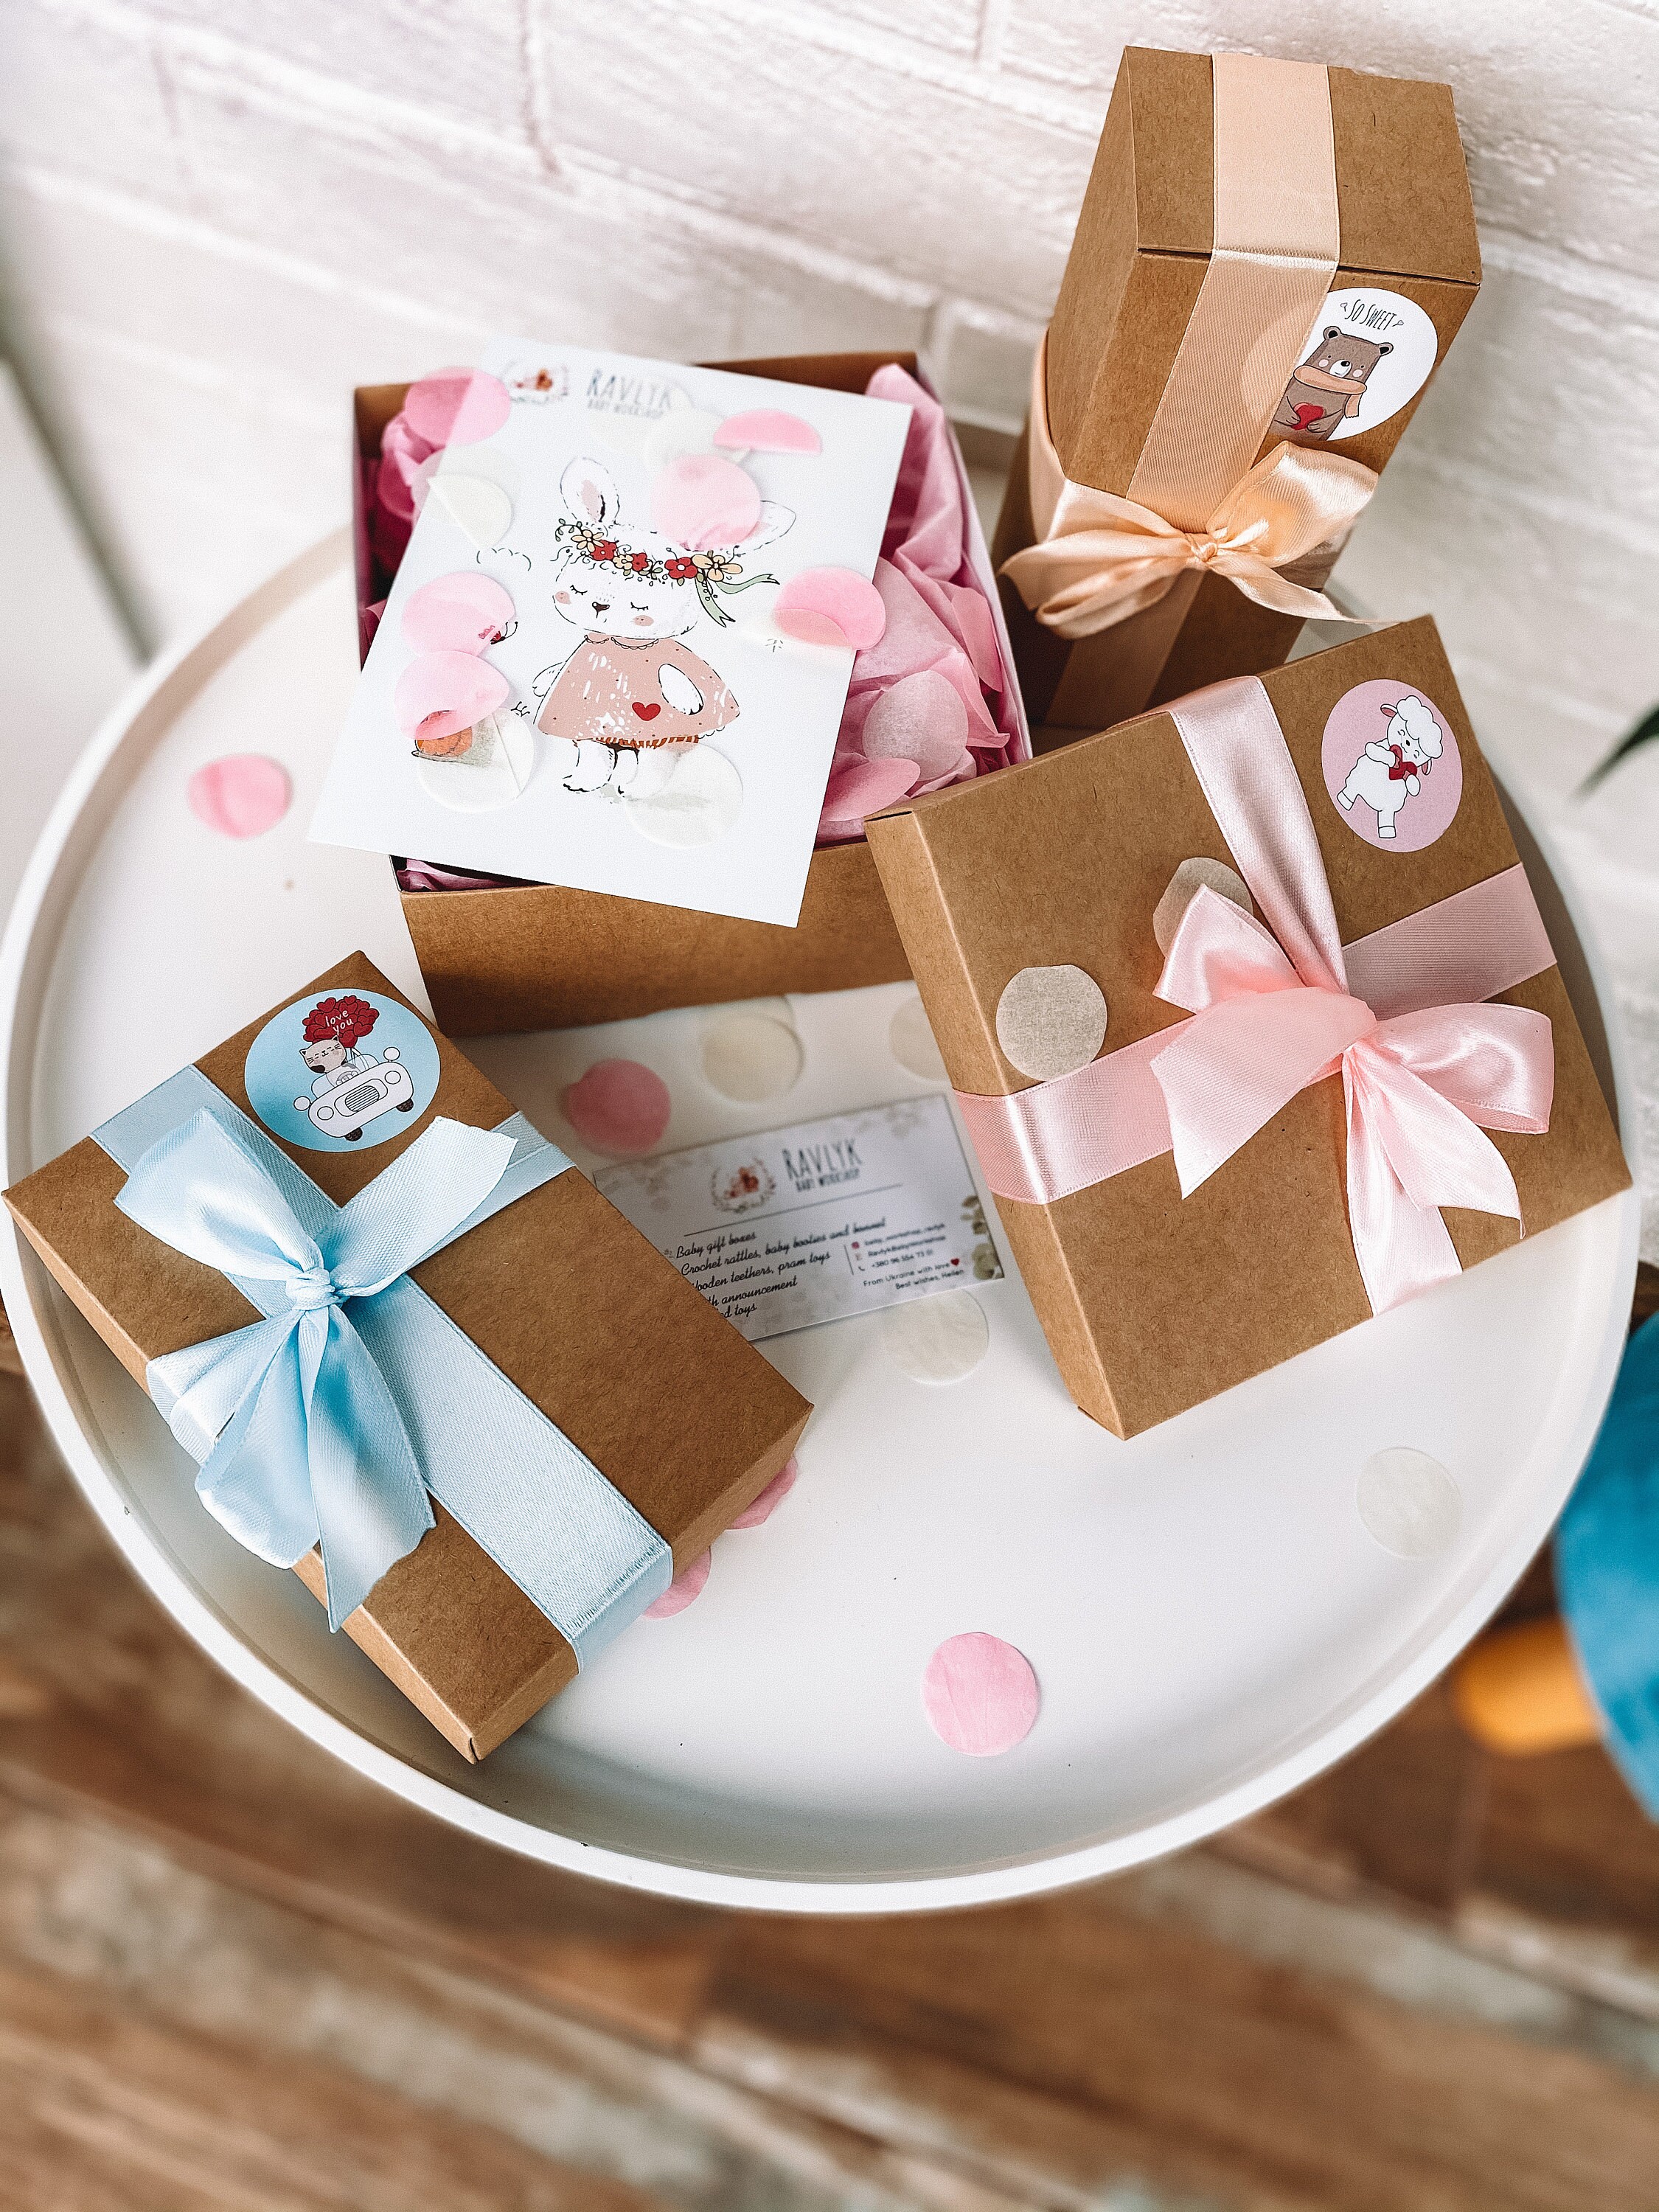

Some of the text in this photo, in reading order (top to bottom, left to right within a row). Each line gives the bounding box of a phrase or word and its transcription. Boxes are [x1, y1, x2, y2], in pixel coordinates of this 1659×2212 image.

[1344, 299, 1397, 330] SO SWEET
[587, 369, 671, 409] RAVLYK
[325, 1009, 349, 1026] love
[333, 1018, 354, 1035] you
[782, 1138, 862, 1180] RAVLYK
[676, 1231, 757, 1258] Baby gift boxes
[681, 1256, 723, 1276] Crochet
[724, 1248, 762, 1265] rattles,
[765, 1240, 790, 1255] baby
[731, 1265, 774, 1283] teethers,
[777, 1257, 807, 1275] pram
[809, 1251, 832, 1265] toys
[863, 1262, 950, 1287] From Ukraine with love
[722, 1275, 798, 1304] announcement
[895, 1281, 911, 1290] Best
[734, 1302, 757, 1318] toys
